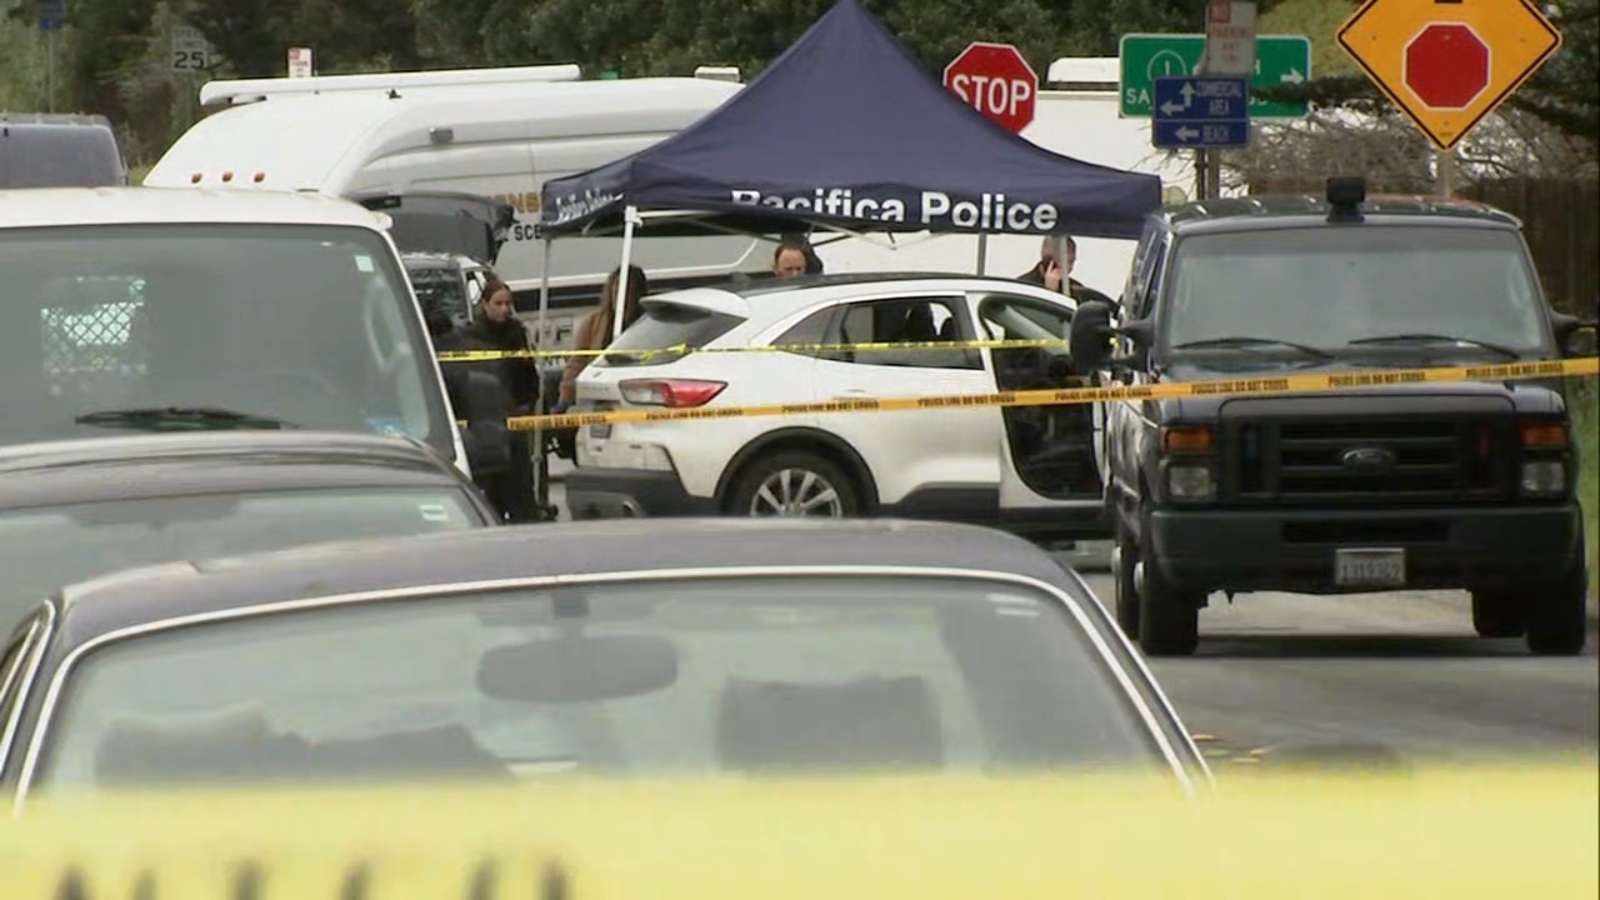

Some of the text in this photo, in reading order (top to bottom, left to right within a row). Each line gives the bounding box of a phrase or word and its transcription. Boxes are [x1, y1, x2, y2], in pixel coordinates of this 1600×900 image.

[174, 51, 205, 70] 25
[953, 74, 1031, 116] STOP
[921, 191, 1058, 230] Police
